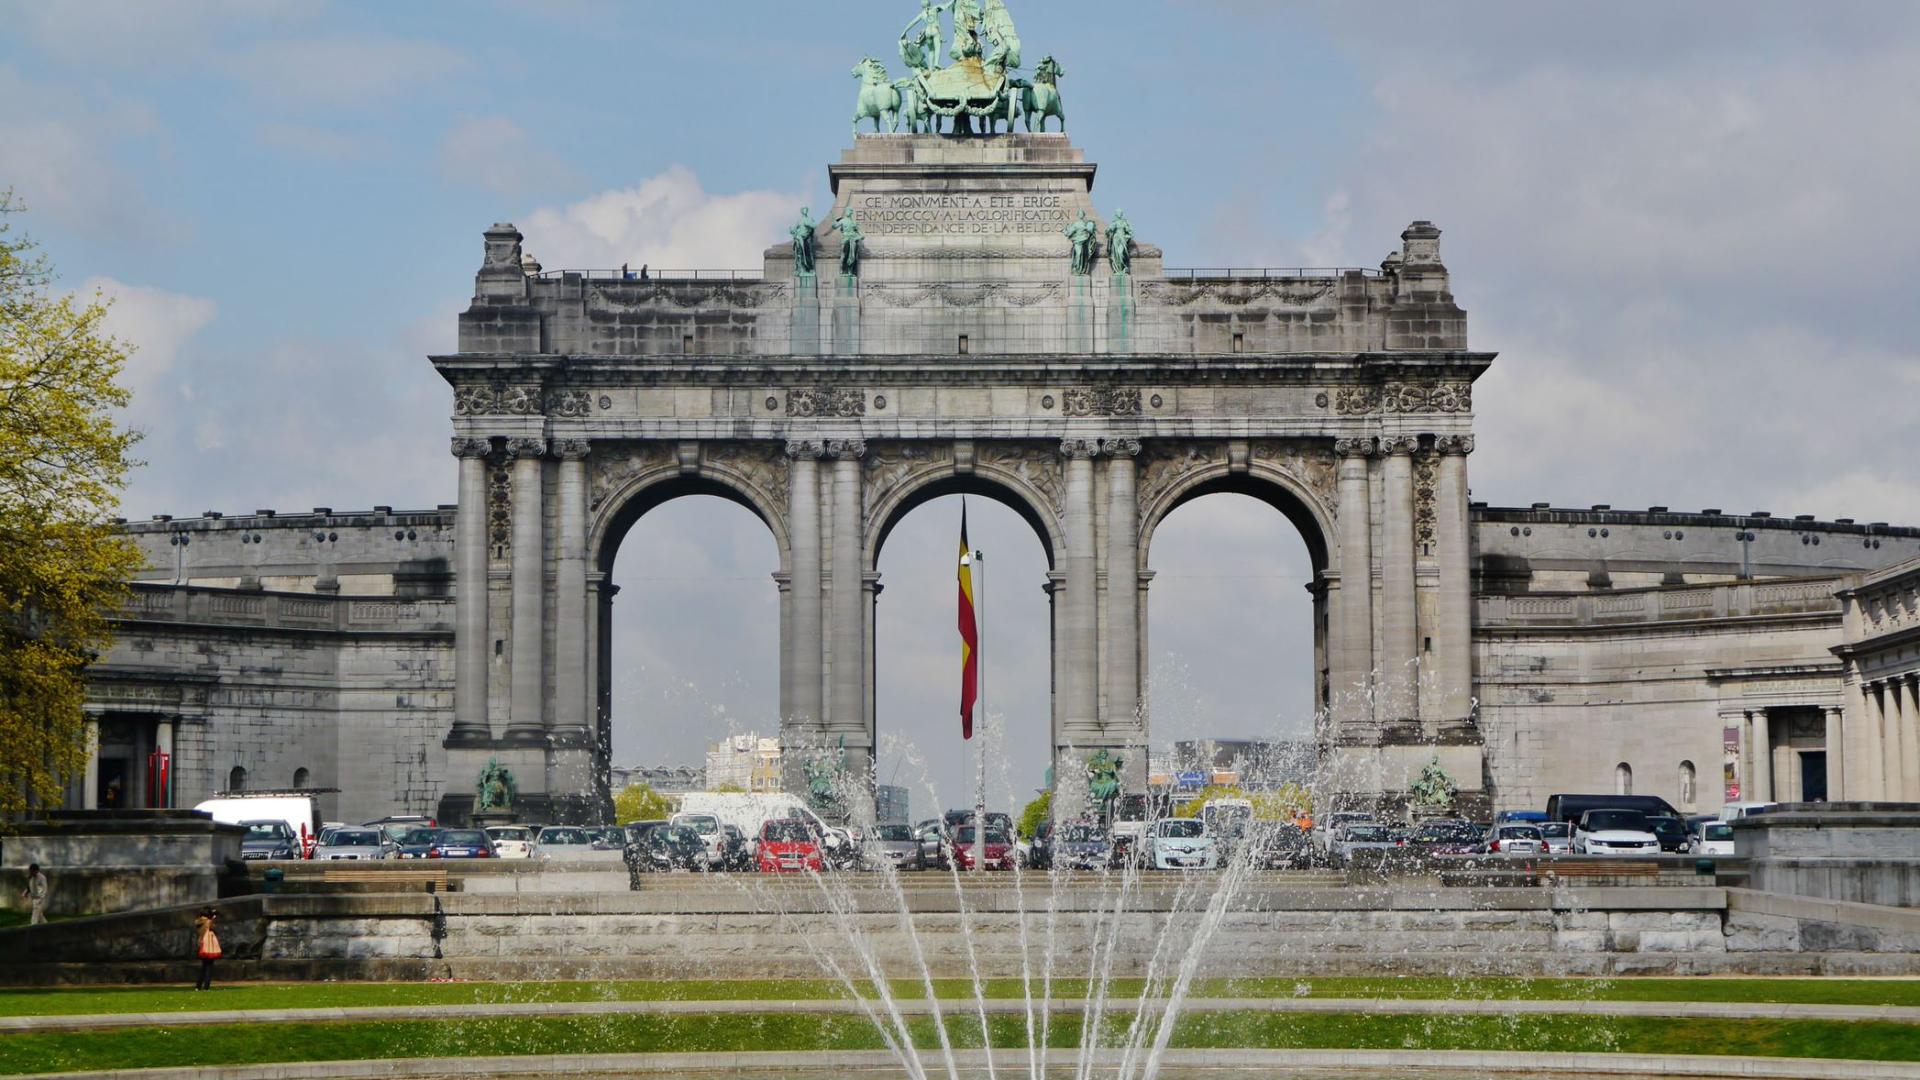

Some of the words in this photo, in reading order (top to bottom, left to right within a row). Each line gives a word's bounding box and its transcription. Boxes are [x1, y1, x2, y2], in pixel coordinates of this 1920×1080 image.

[865, 196, 882, 208] CE
[890, 196, 968, 208] MONVMENT
[973, 197, 983, 208] A
[990, 196, 1014, 208] ETE
[1023, 196, 1060, 208] ERIGE
[943, 211, 953, 221] A
[972, 223, 988, 233] DE
[994, 223, 1010, 233] LA
